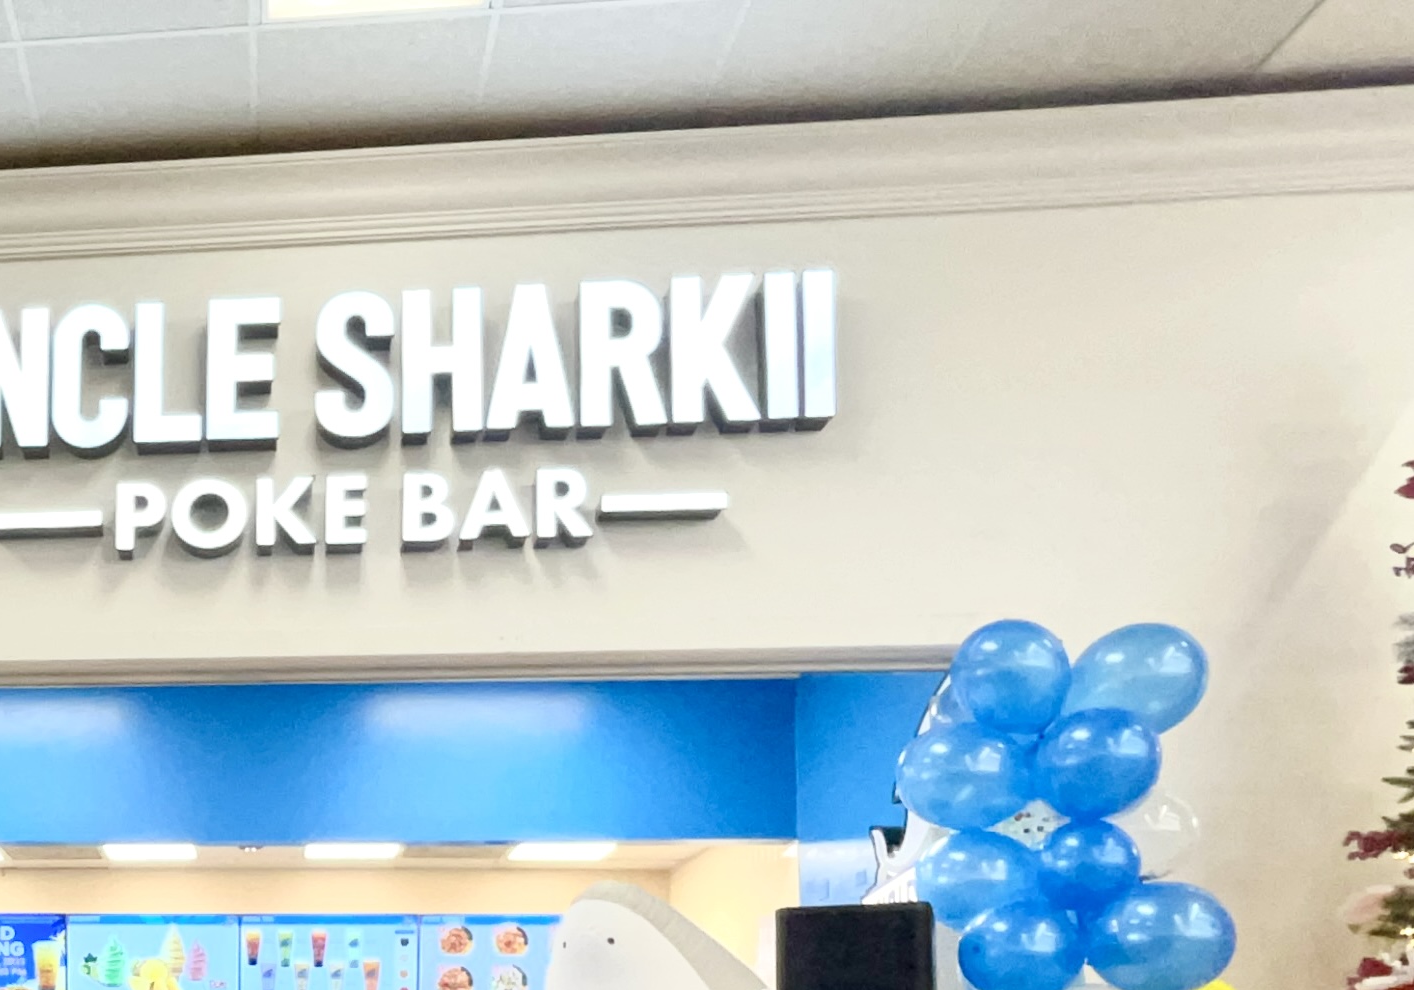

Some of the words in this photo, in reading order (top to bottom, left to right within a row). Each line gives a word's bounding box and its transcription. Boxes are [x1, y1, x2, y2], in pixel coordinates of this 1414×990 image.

[314, 268, 837, 444] SHARKII
[115, 474, 368, 555] POKE
[400, 466, 594, 550] BAR
